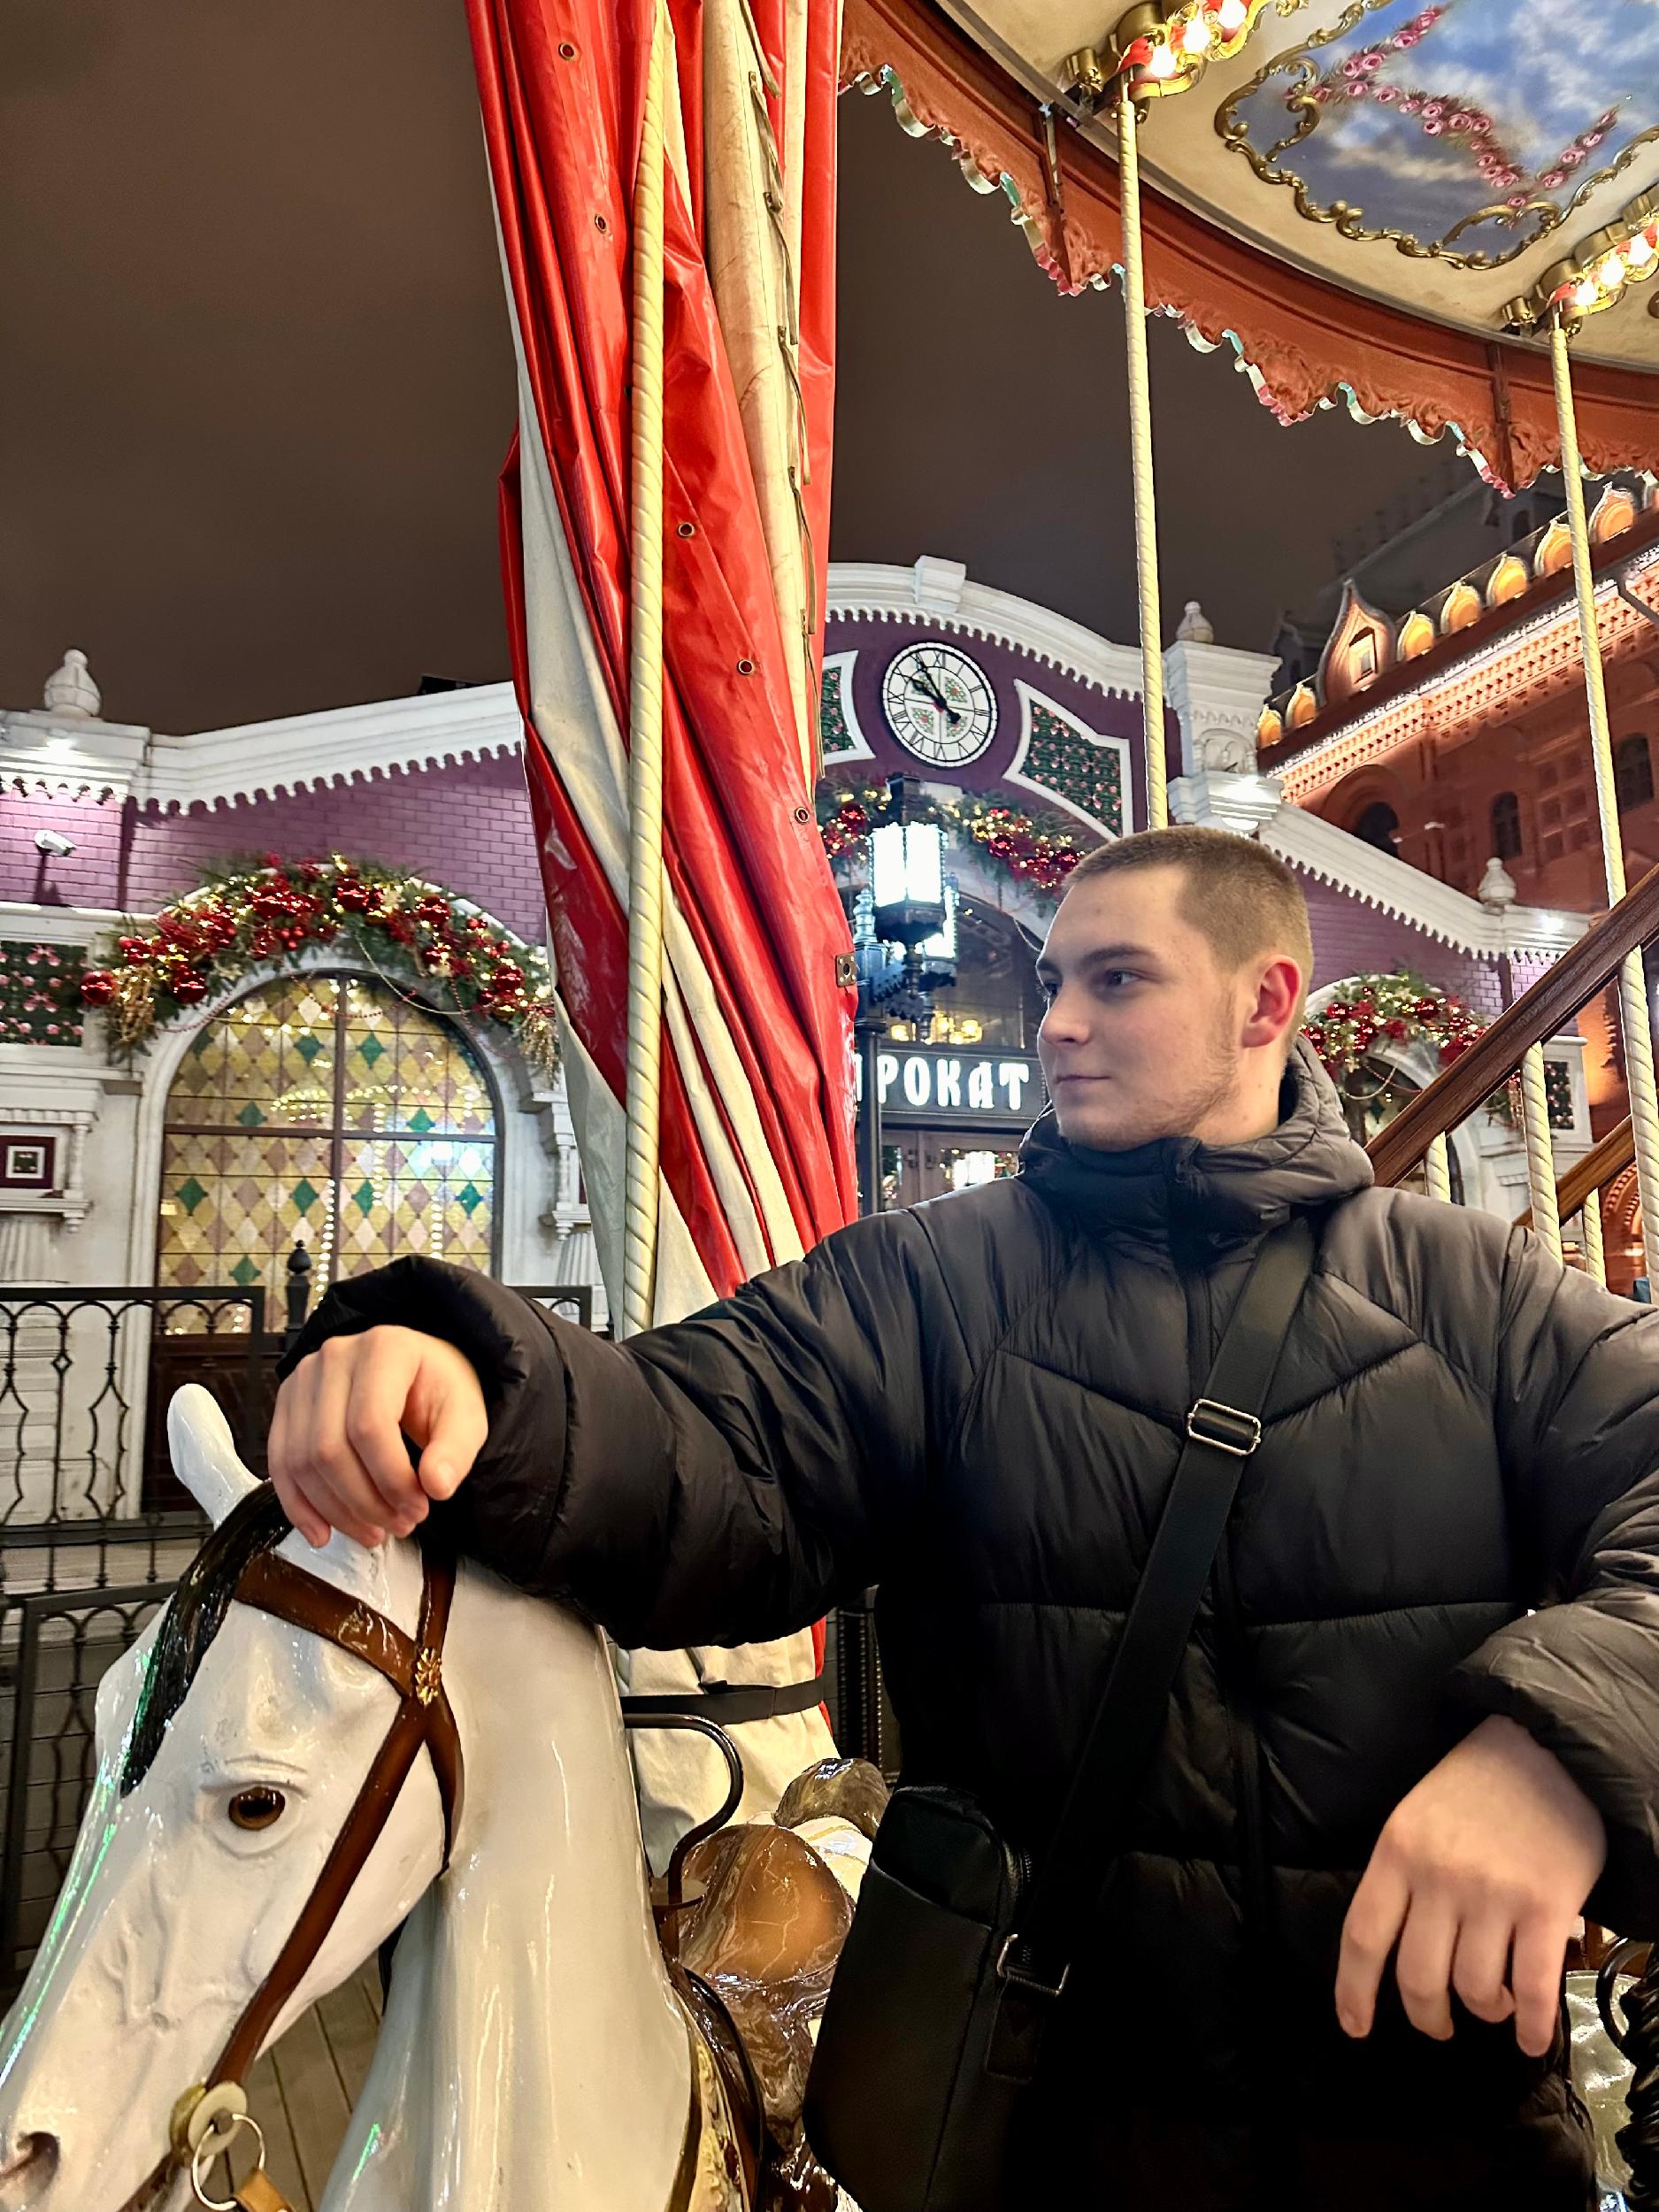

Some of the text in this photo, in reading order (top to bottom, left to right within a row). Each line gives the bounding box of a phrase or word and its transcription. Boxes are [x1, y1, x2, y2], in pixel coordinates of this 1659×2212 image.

[893, 665, 912, 684] X
[887, 690, 905, 704] IX
[974, 708, 990, 717] III
[970, 724, 987, 744] IV
[933, 742, 947, 761] VI
[957, 741, 970, 758] V
